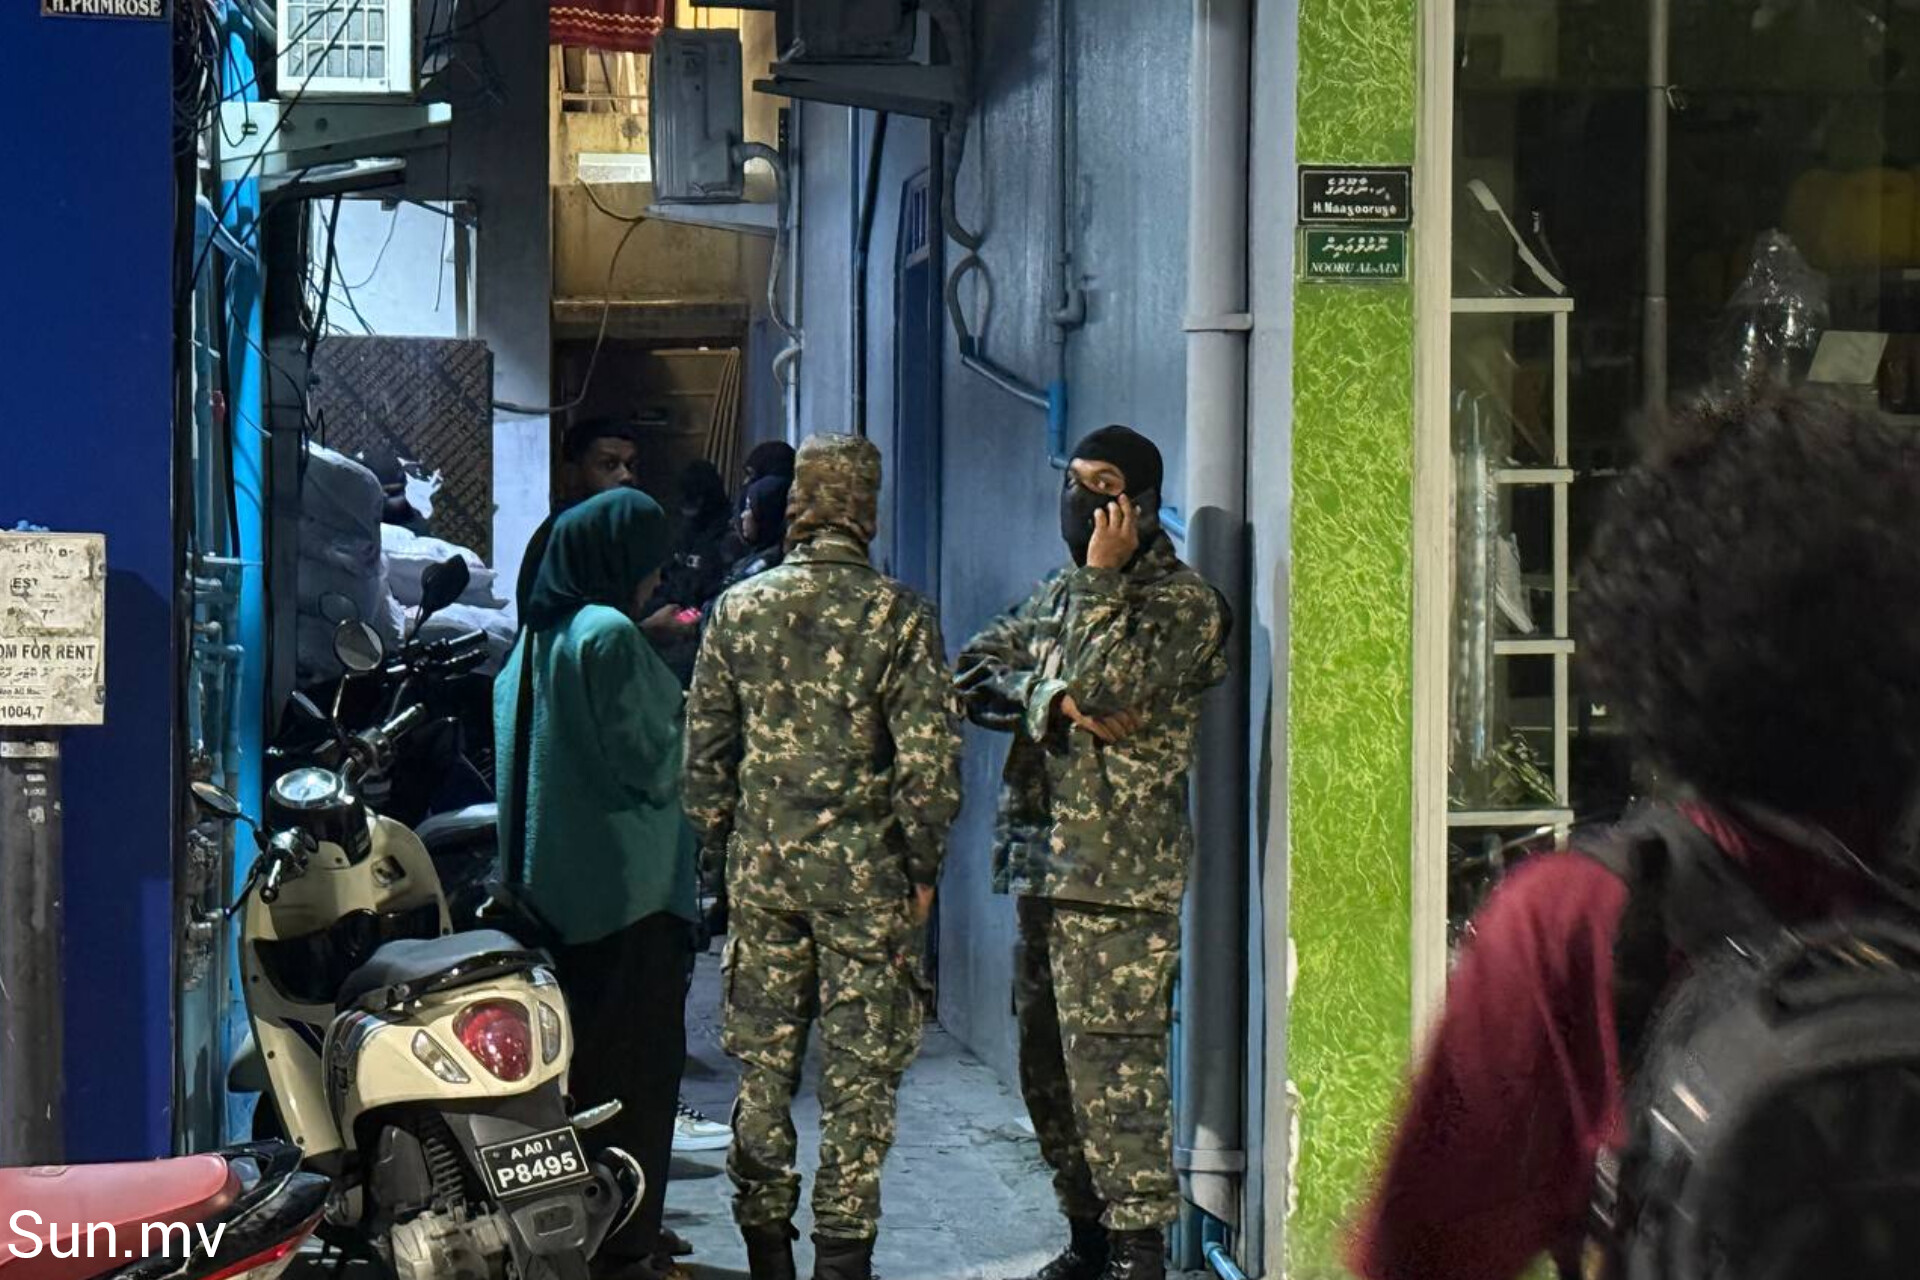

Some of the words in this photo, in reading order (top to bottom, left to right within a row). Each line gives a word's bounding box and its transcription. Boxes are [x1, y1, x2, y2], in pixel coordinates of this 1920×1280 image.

[53, 0, 161, 16] H.PRIMROSE
[1310, 261, 1355, 273] NOORU
[22, 644, 52, 660] FOR
[56, 644, 95, 660] RENT
[497, 1151, 578, 1189] P8495
